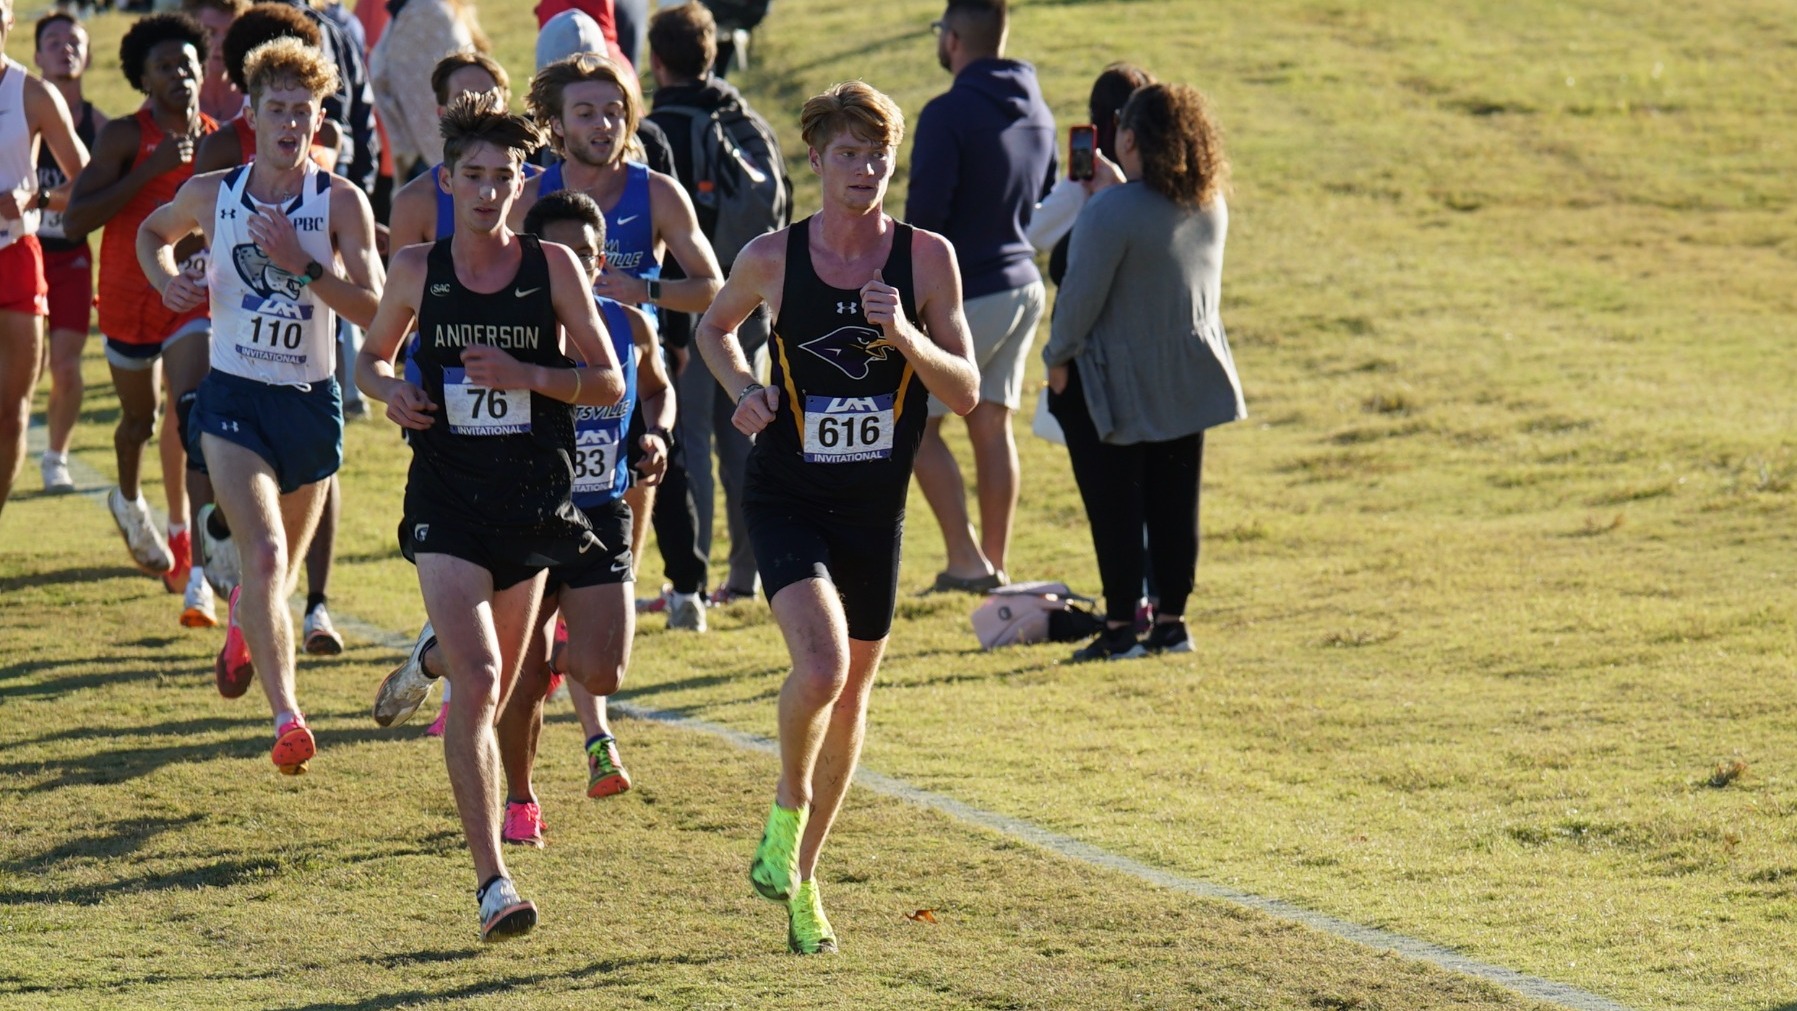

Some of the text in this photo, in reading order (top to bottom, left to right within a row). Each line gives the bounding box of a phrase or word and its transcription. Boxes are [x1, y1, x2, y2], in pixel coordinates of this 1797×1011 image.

[294, 216, 324, 231] PBC
[433, 283, 451, 293] SAC
[251, 316, 302, 349] 110
[435, 324, 539, 349] ANDERSON
[241, 347, 300, 364] INVITATIONAL
[467, 388, 508, 419] 76
[575, 399, 631, 420] TSVILLE
[457, 425, 523, 436] INVITATIONAL
[818, 416, 880, 448] 616
[814, 451, 883, 463] INVITATIONAL
[573, 483, 610, 492] ITATION
